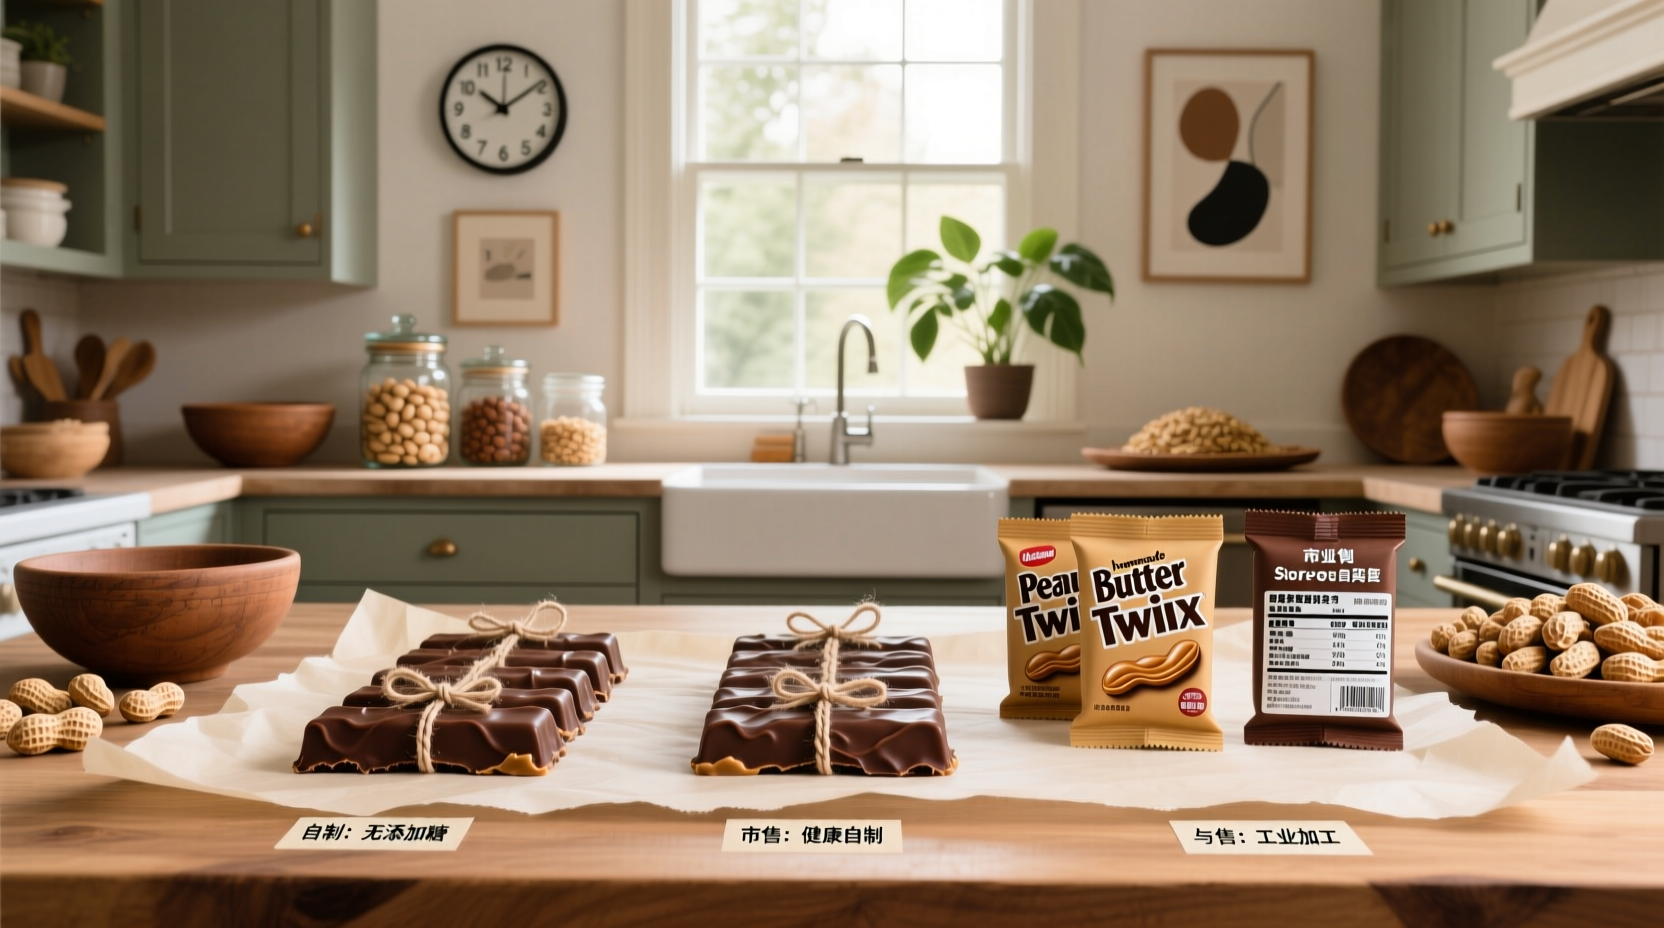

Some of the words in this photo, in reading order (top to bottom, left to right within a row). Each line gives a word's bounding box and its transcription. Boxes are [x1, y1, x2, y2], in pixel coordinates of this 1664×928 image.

[476, 62, 489, 78] 11
[495, 56, 513, 72] 12
[523, 63, 529, 78] 1
[459, 80, 476, 96] 10
[536, 79, 548, 94] 2
[453, 101, 465, 117] 9
[541, 102, 552, 117] 3
[460, 124, 472, 140] 8
[535, 124, 546, 138] 4
[477, 140, 488, 156] 7
[498, 145, 509, 162] 6
[520, 140, 532, 156] 5
[1091, 560, 1186, 604] Butter
